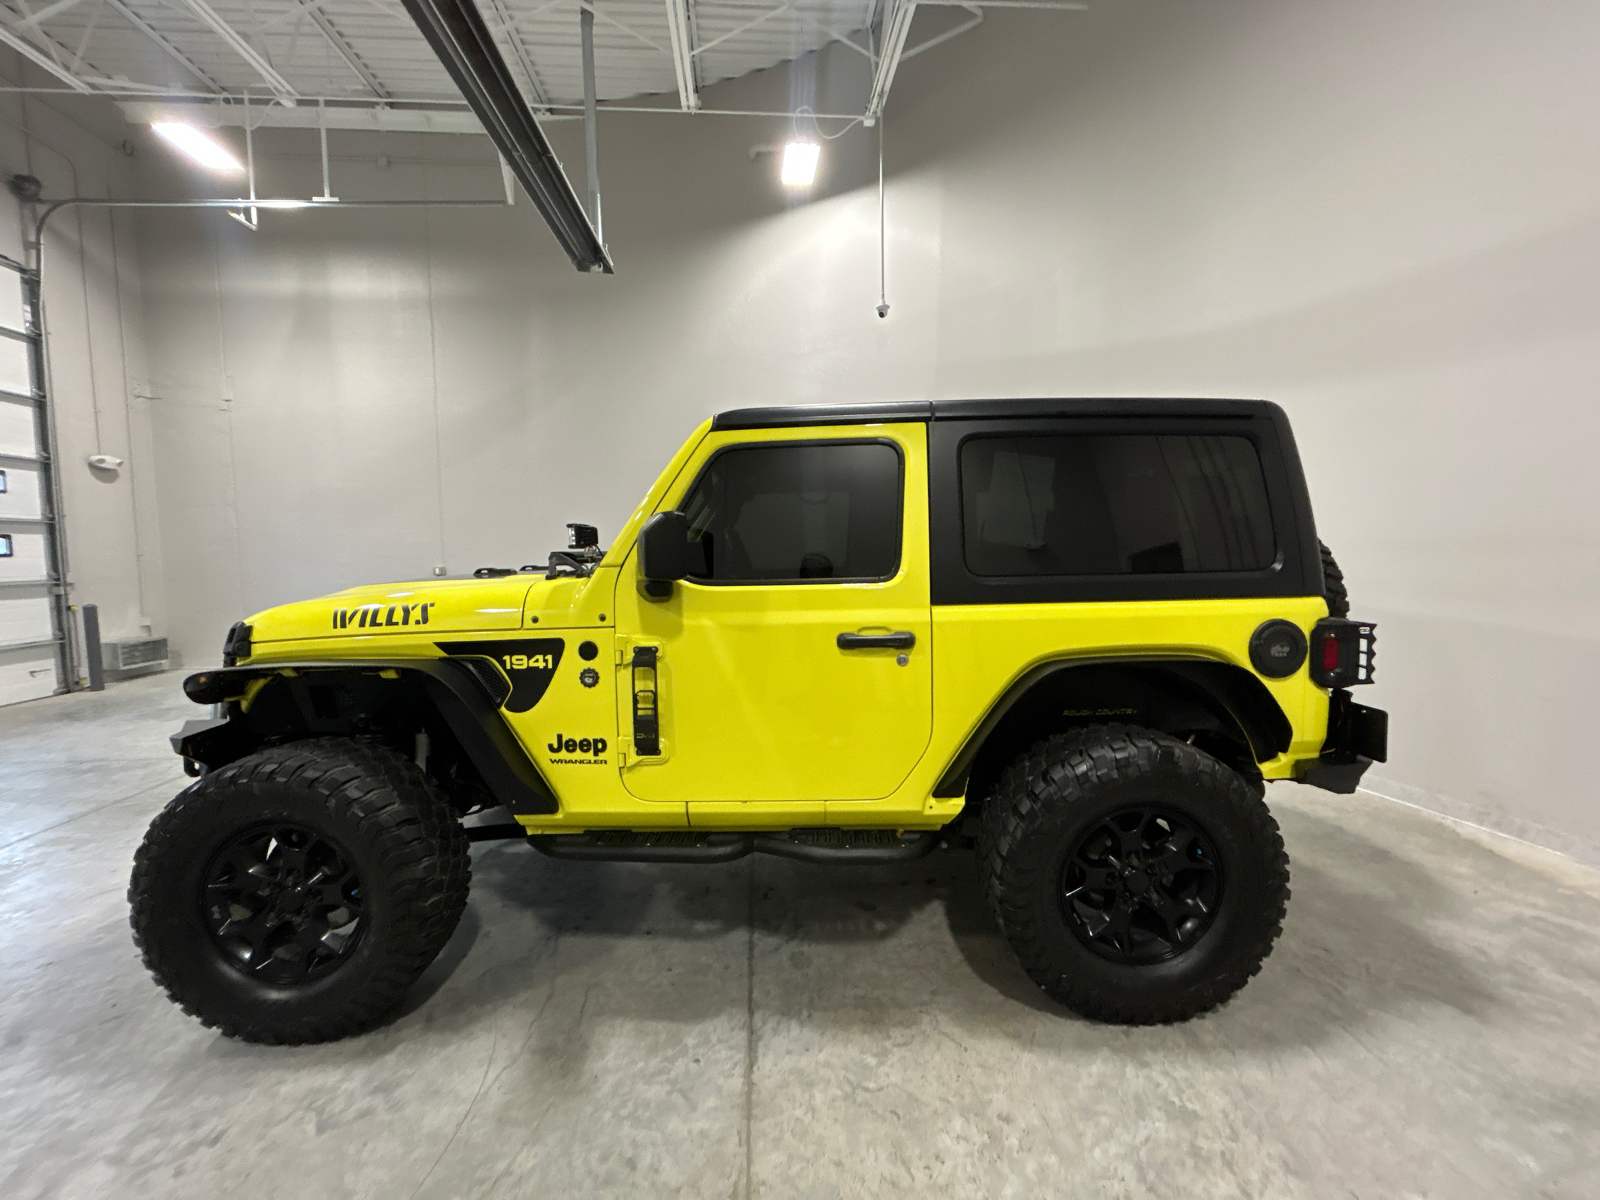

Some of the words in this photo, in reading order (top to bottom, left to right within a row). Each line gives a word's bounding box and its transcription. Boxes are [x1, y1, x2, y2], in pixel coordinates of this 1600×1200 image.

[333, 602, 435, 629] WILLYS
[502, 654, 553, 670] 1941
[547, 733, 608, 757] Jeep
